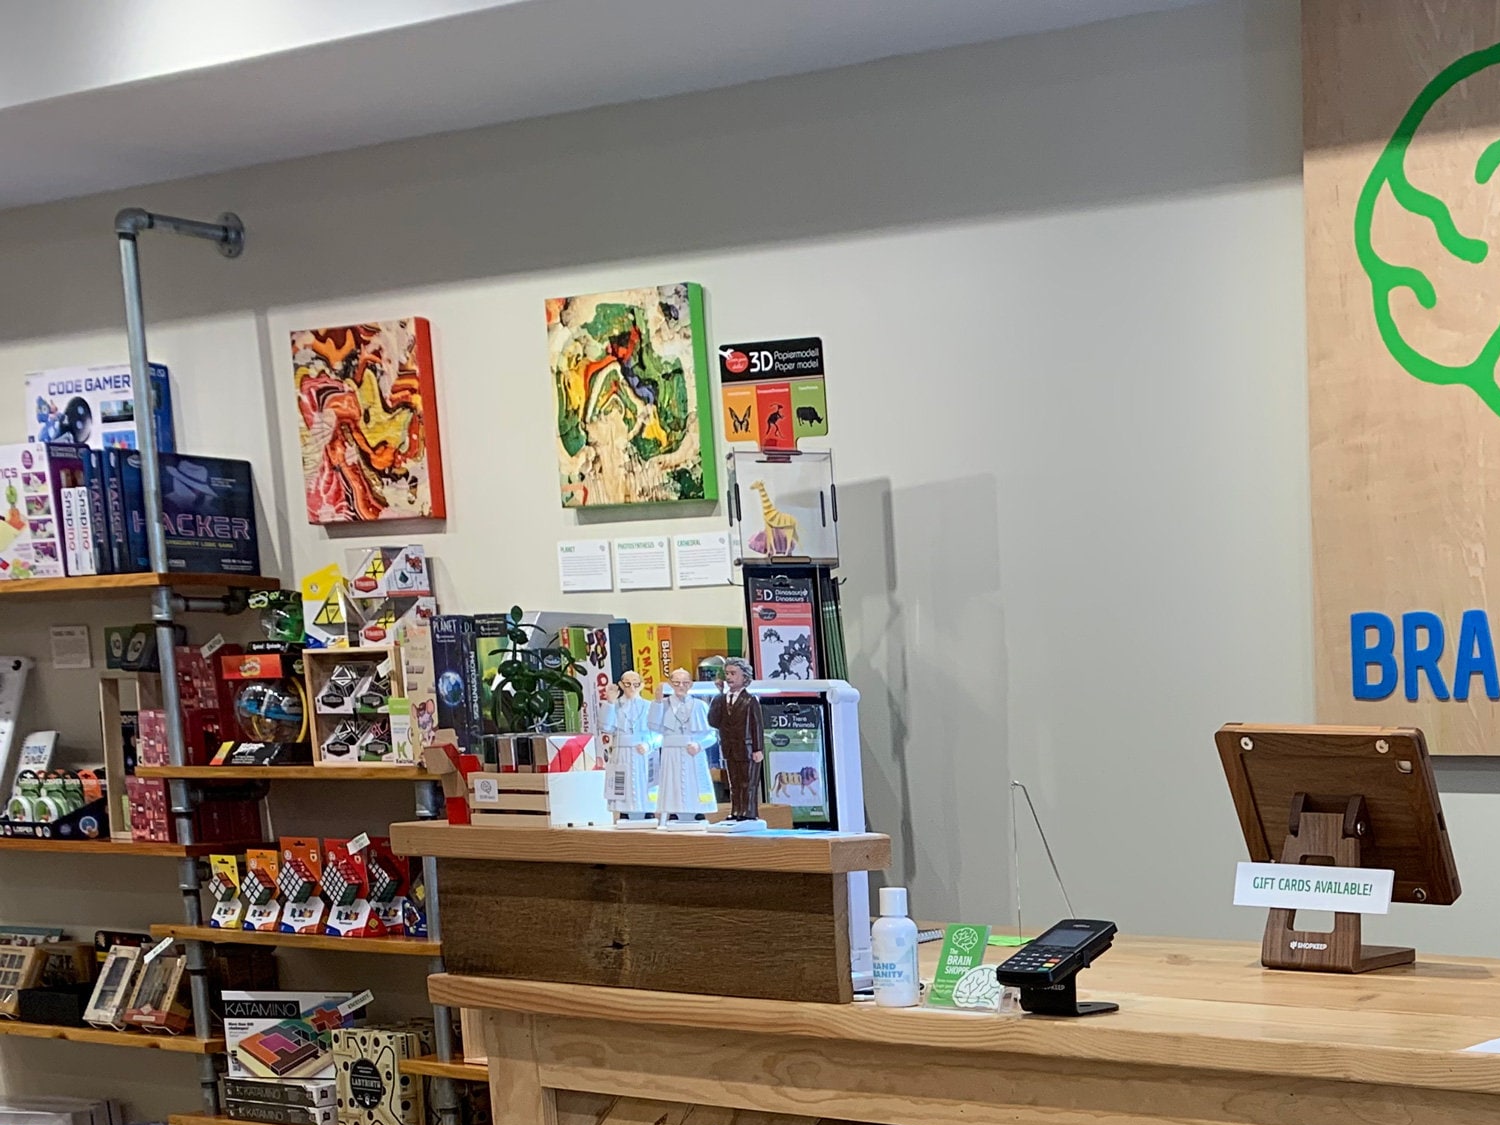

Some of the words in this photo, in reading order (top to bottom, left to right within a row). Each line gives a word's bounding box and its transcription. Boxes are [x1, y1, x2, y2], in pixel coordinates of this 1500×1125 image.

[749, 351, 773, 372] 3D
[774, 362, 795, 373] Paper
[797, 359, 819, 369] model
[48, 381, 82, 396] CODE
[84, 374, 131, 392] GAMER
[90, 478, 104, 543] HACKER
[108, 477, 123, 543] HACKER
[755, 588, 773, 602] 3D
[432, 620, 457, 634] PLANET
[771, 715, 788, 729] 3D
[1252, 876, 1275, 890] GIFT
[1278, 878, 1311, 892] CARDS
[1314, 880, 1373, 896] AVAILABLE!
[949, 947, 959, 955] The
[946, 955, 973, 966] BRAIN
[224, 1001, 298, 1018] KATAMINO
[351, 1077, 381, 1089] LABYRINTH
[243, 1086, 281, 1100] KATAMINO
[245, 1108, 284, 1122] KATAMINO
